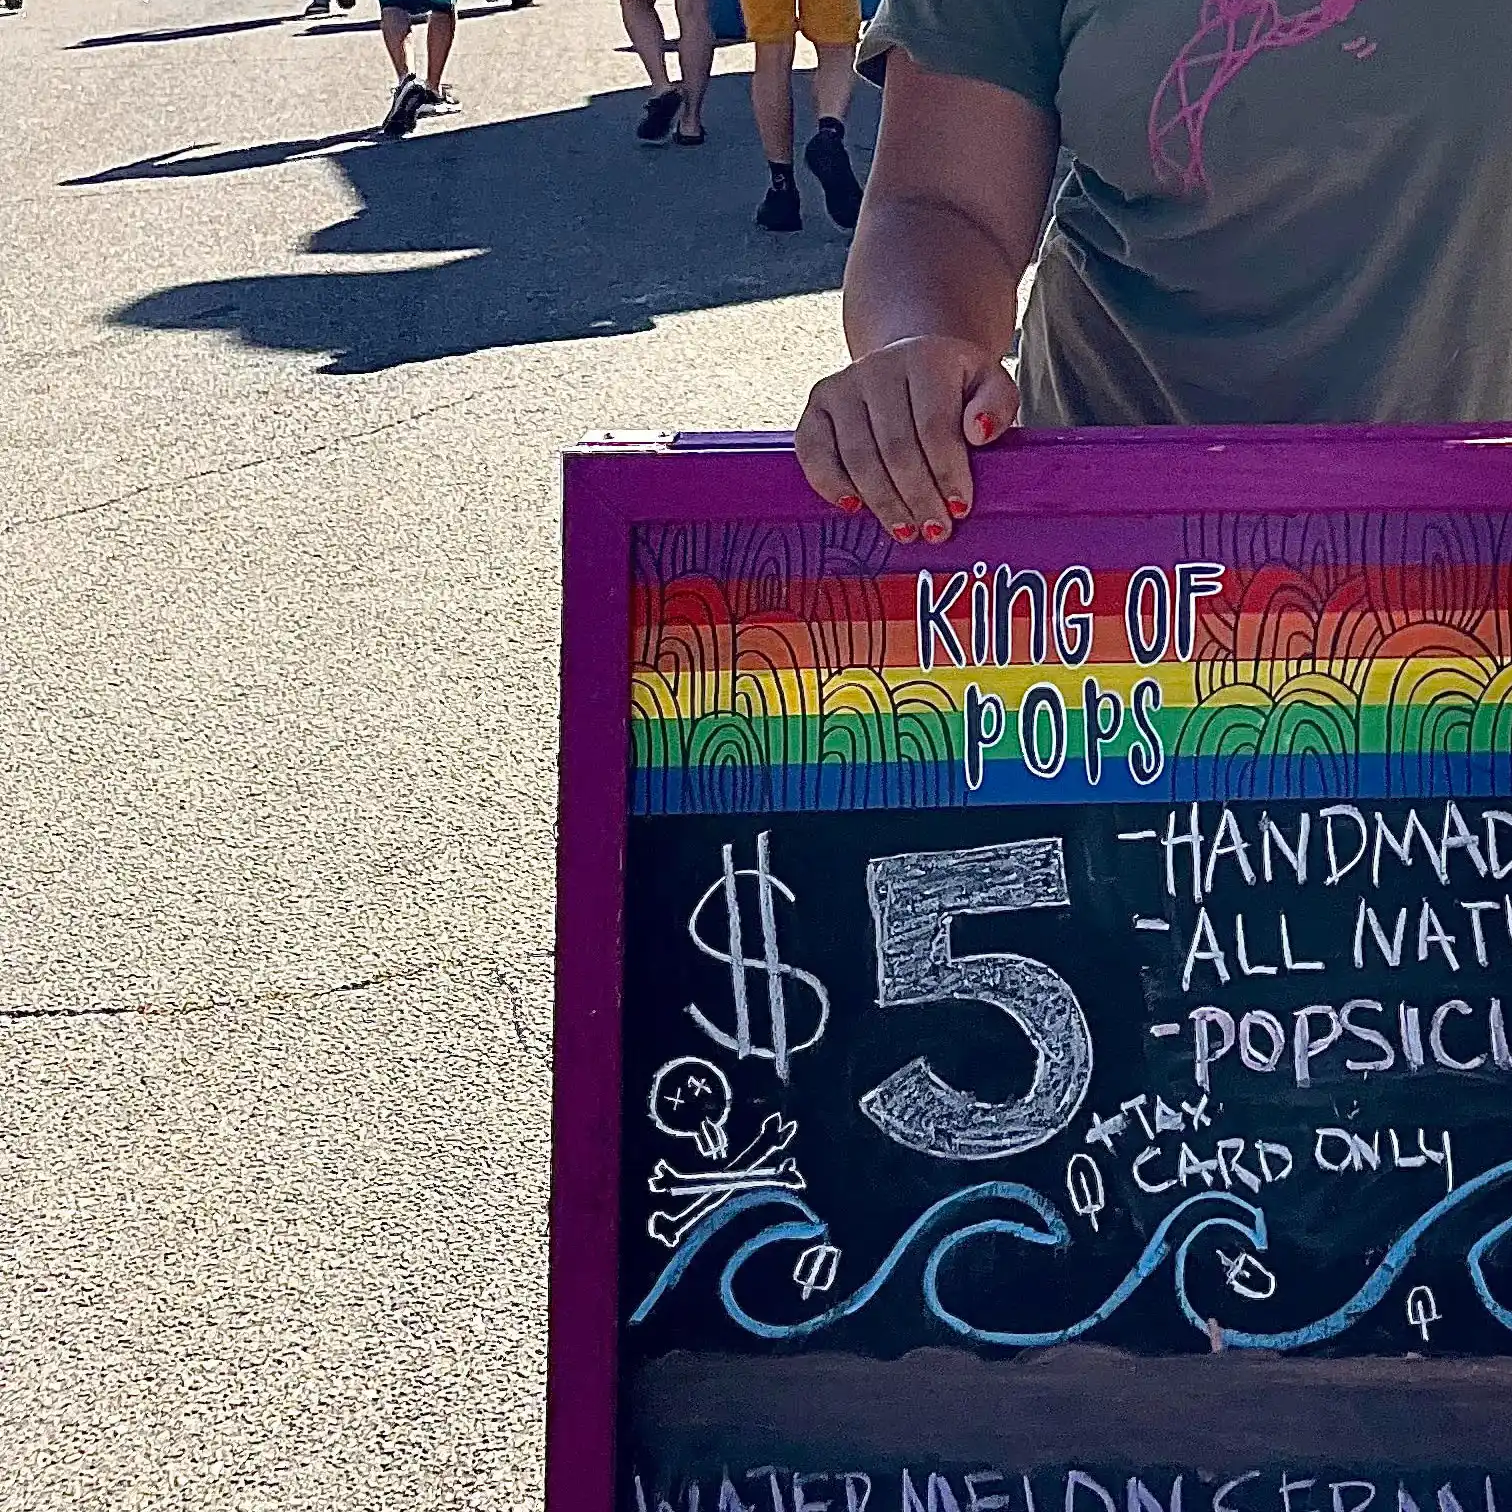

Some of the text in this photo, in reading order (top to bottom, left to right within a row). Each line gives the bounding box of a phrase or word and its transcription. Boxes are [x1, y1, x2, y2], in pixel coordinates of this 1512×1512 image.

[1126, 563, 1226, 667] OF
[1132, 1127, 1454, 1194] CARD ONLY
